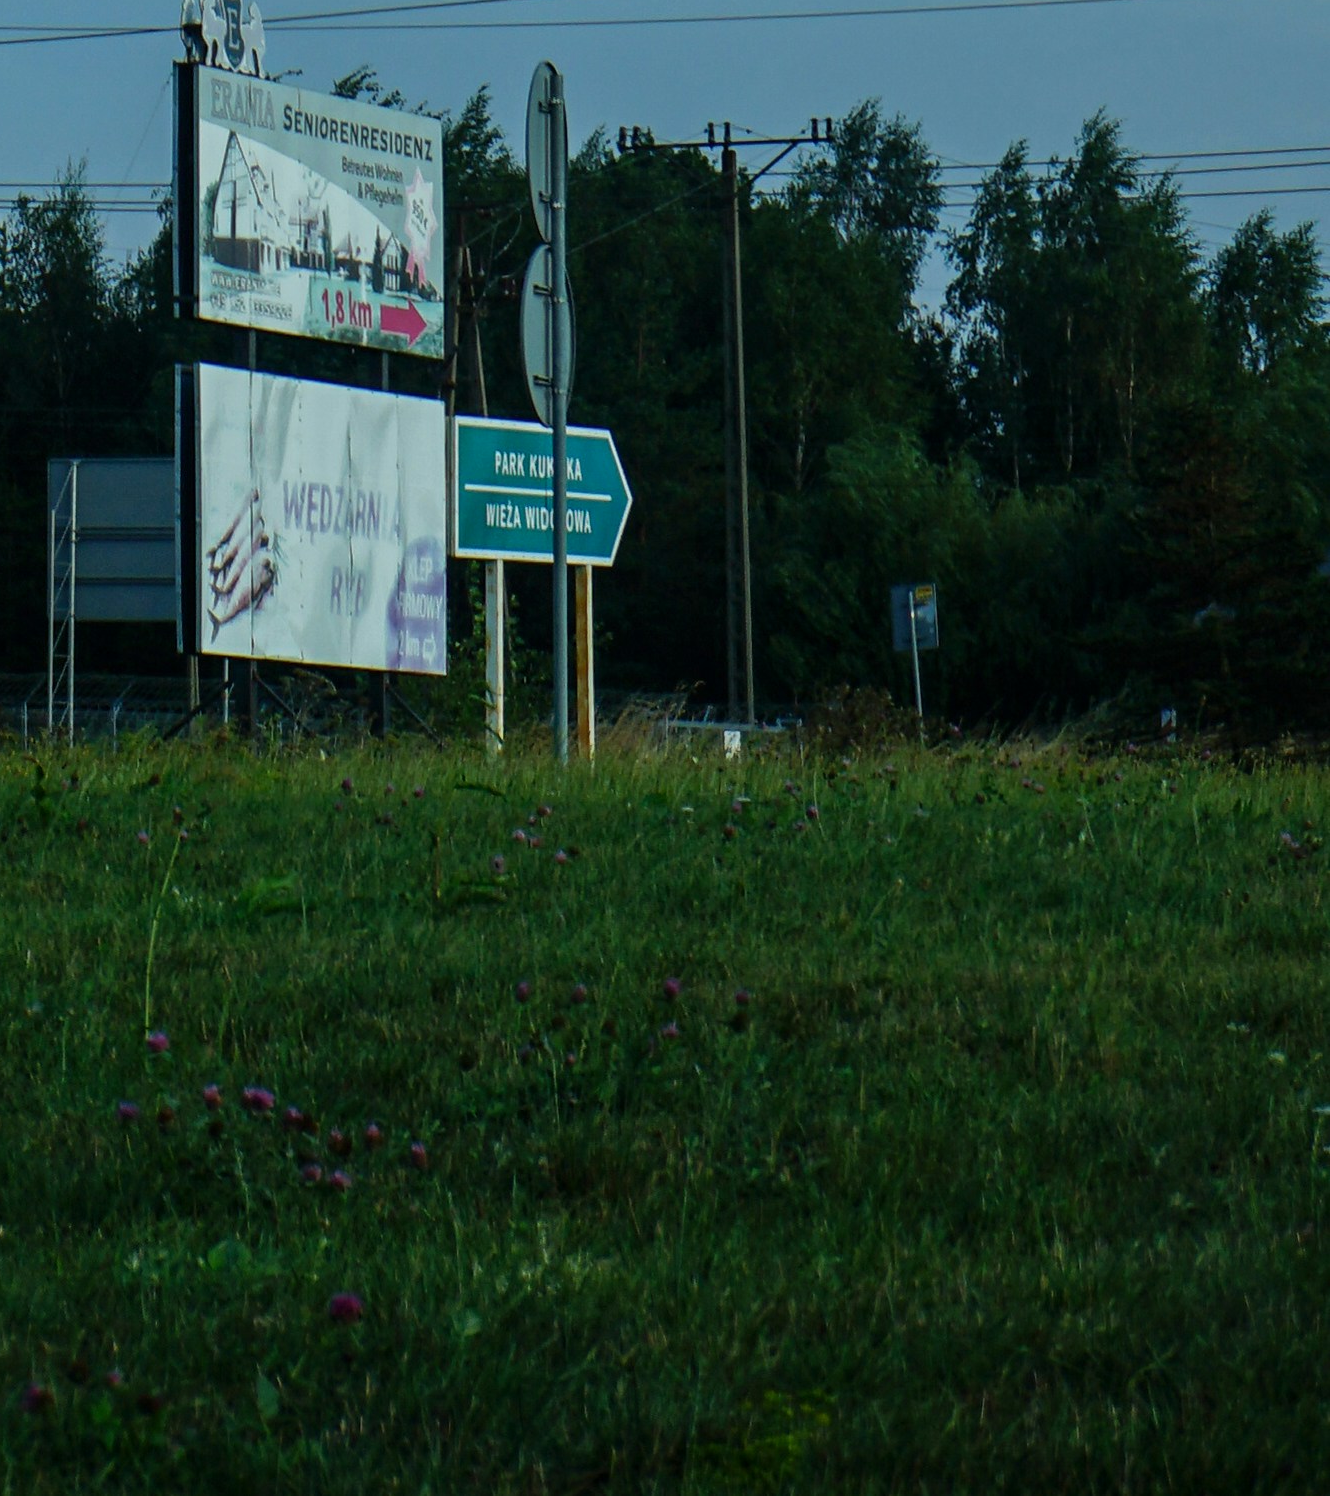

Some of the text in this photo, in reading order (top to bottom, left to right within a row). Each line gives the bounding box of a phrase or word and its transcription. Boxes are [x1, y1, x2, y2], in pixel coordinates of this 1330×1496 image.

[228, 8, 240, 49] E
[211, 78, 276, 130] ERANIA
[322, 288, 345, 330] 1,8
[348, 288, 372, 328] km
[495, 451, 525, 477] PARK
[486, 500, 592, 534] WIEŻA WIDOOWA
